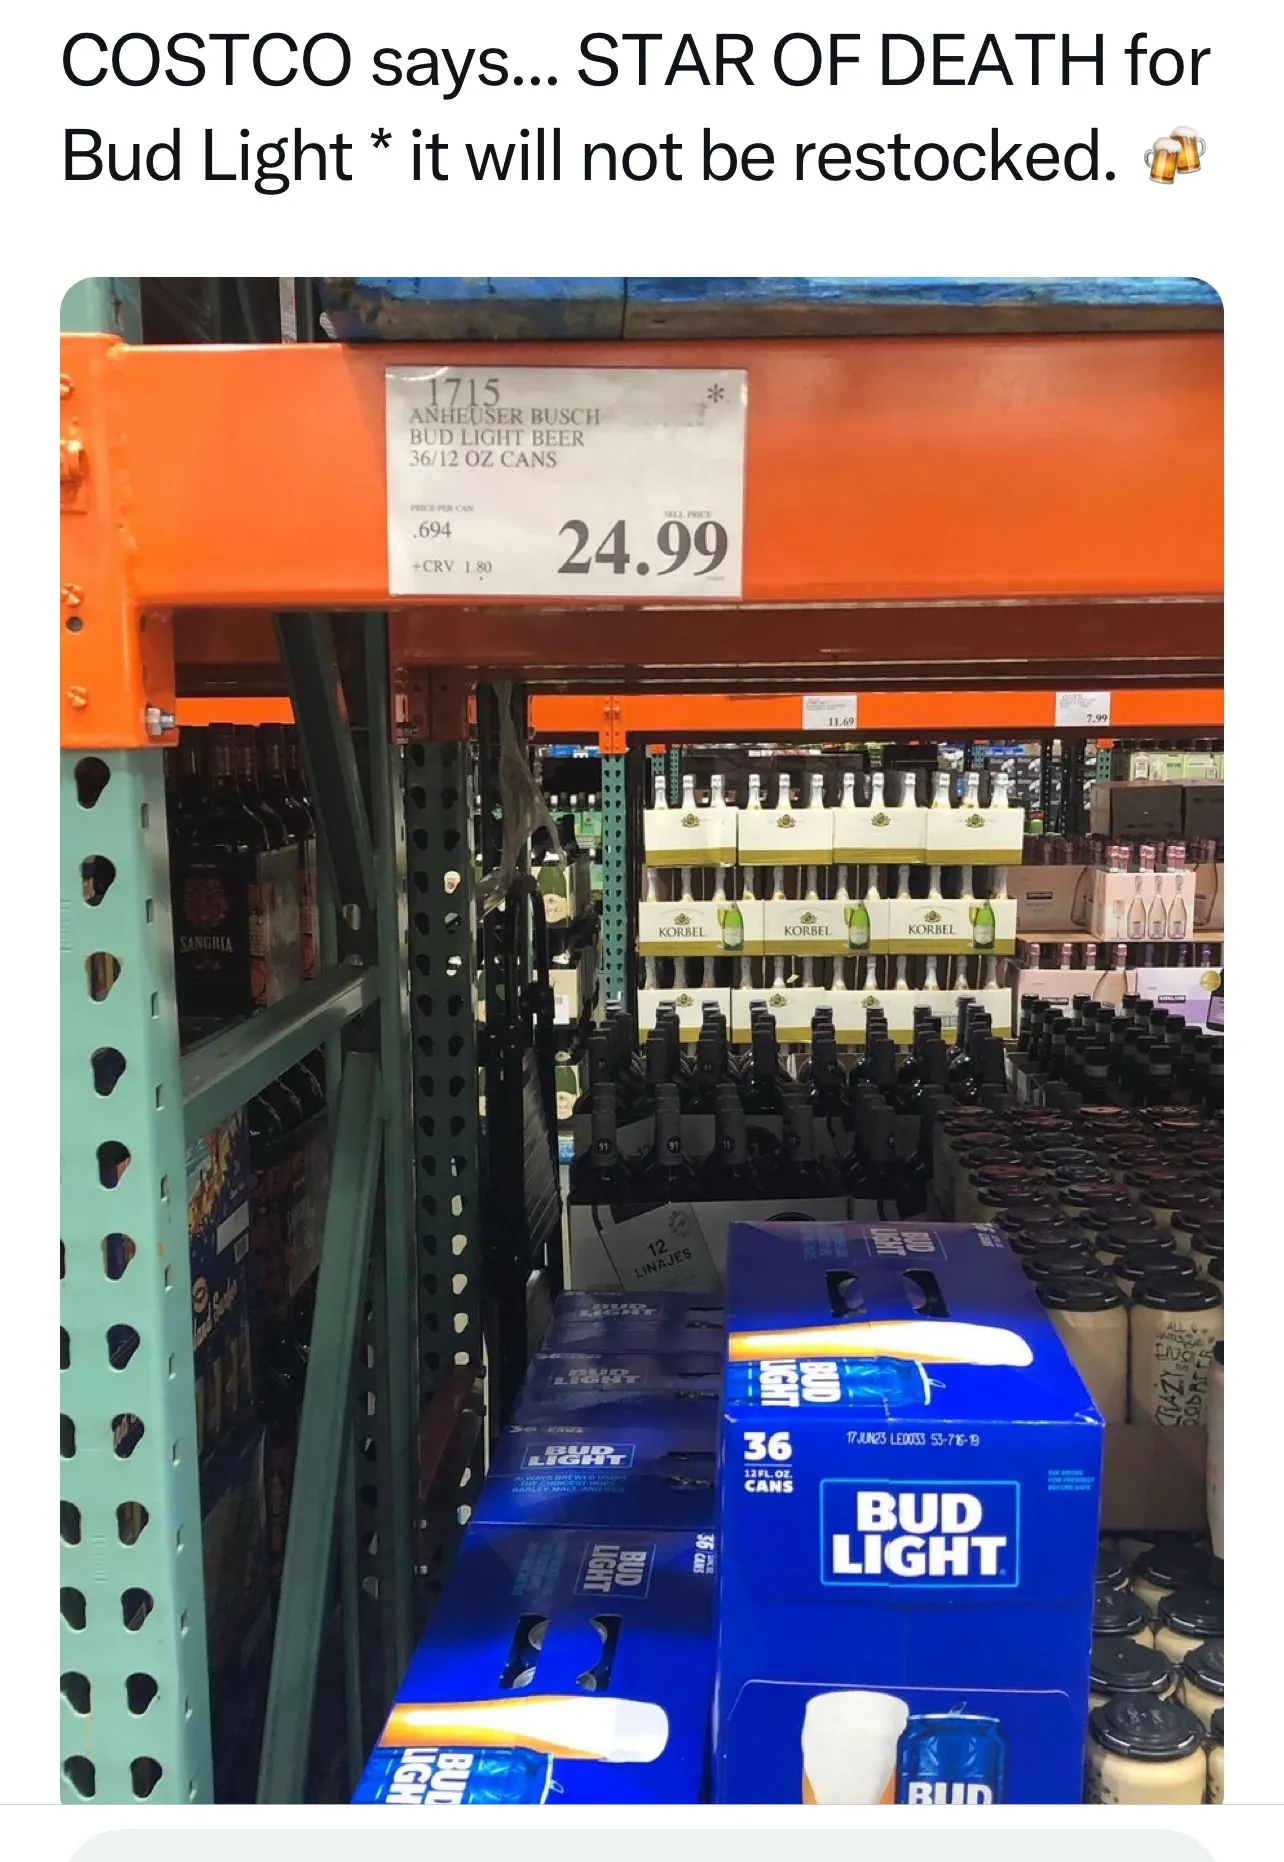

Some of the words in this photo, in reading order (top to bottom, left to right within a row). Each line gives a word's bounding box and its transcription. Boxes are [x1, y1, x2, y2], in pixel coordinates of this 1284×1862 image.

[430, 378, 500, 407] 1715
[410, 408, 523, 425] ANHEUSER
[531, 408, 600, 426] BUSCH
[410, 430, 453, 446] BUD
[461, 430, 525, 446] LIGHT
[532, 430, 584, 447] BEER
[410, 450, 459, 467] 36/12
[465, 450, 494, 467] OZ
[500, 451, 557, 468] CANS
[411, 504, 435, 512] PRICE
[437, 504, 453, 512] PER
[455, 504, 474, 512] CAN
[413, 520, 452, 539] .694
[557, 519, 729, 576] 24.99
[411, 559, 454, 573] +CRV
[465, 560, 492, 573] 1.80
[828, 716, 855, 727] 11.69
[1086, 713, 1109, 723] 7.99
[658, 926, 706, 938] KORBEL
[784, 925, 831, 937] KORBEL
[908, 924, 956, 936] KORBEL
[180, 935, 233, 954] SANGRIA
[647, 1239, 669, 1256] 12
[634, 1247, 692, 1279] LINAJES
[554, 1375, 640, 1385] LIGHT
[567, 1369, 630, 1377] BUD
[800, 1361, 841, 1403] BUD
[760, 1359, 800, 1408] LIGHT
[545, 1445, 615, 1456] BUD
[743, 1431, 793, 1461] 36
[528, 1454, 627, 1467] LIGHT
[744, 1479, 794, 1494] CANS
[857, 1490, 983, 1533] BUD
[695, 1533, 716, 1551] 36
[832, 1534, 1008, 1577] LIGHT
[583, 1545, 620, 1593] LIGHT
[614, 1551, 648, 1588] BUD
[385, 1747, 439, 1804] LIGH
[424, 1753, 475, 1805] BUD
[908, 1782, 993, 1805] BUD
